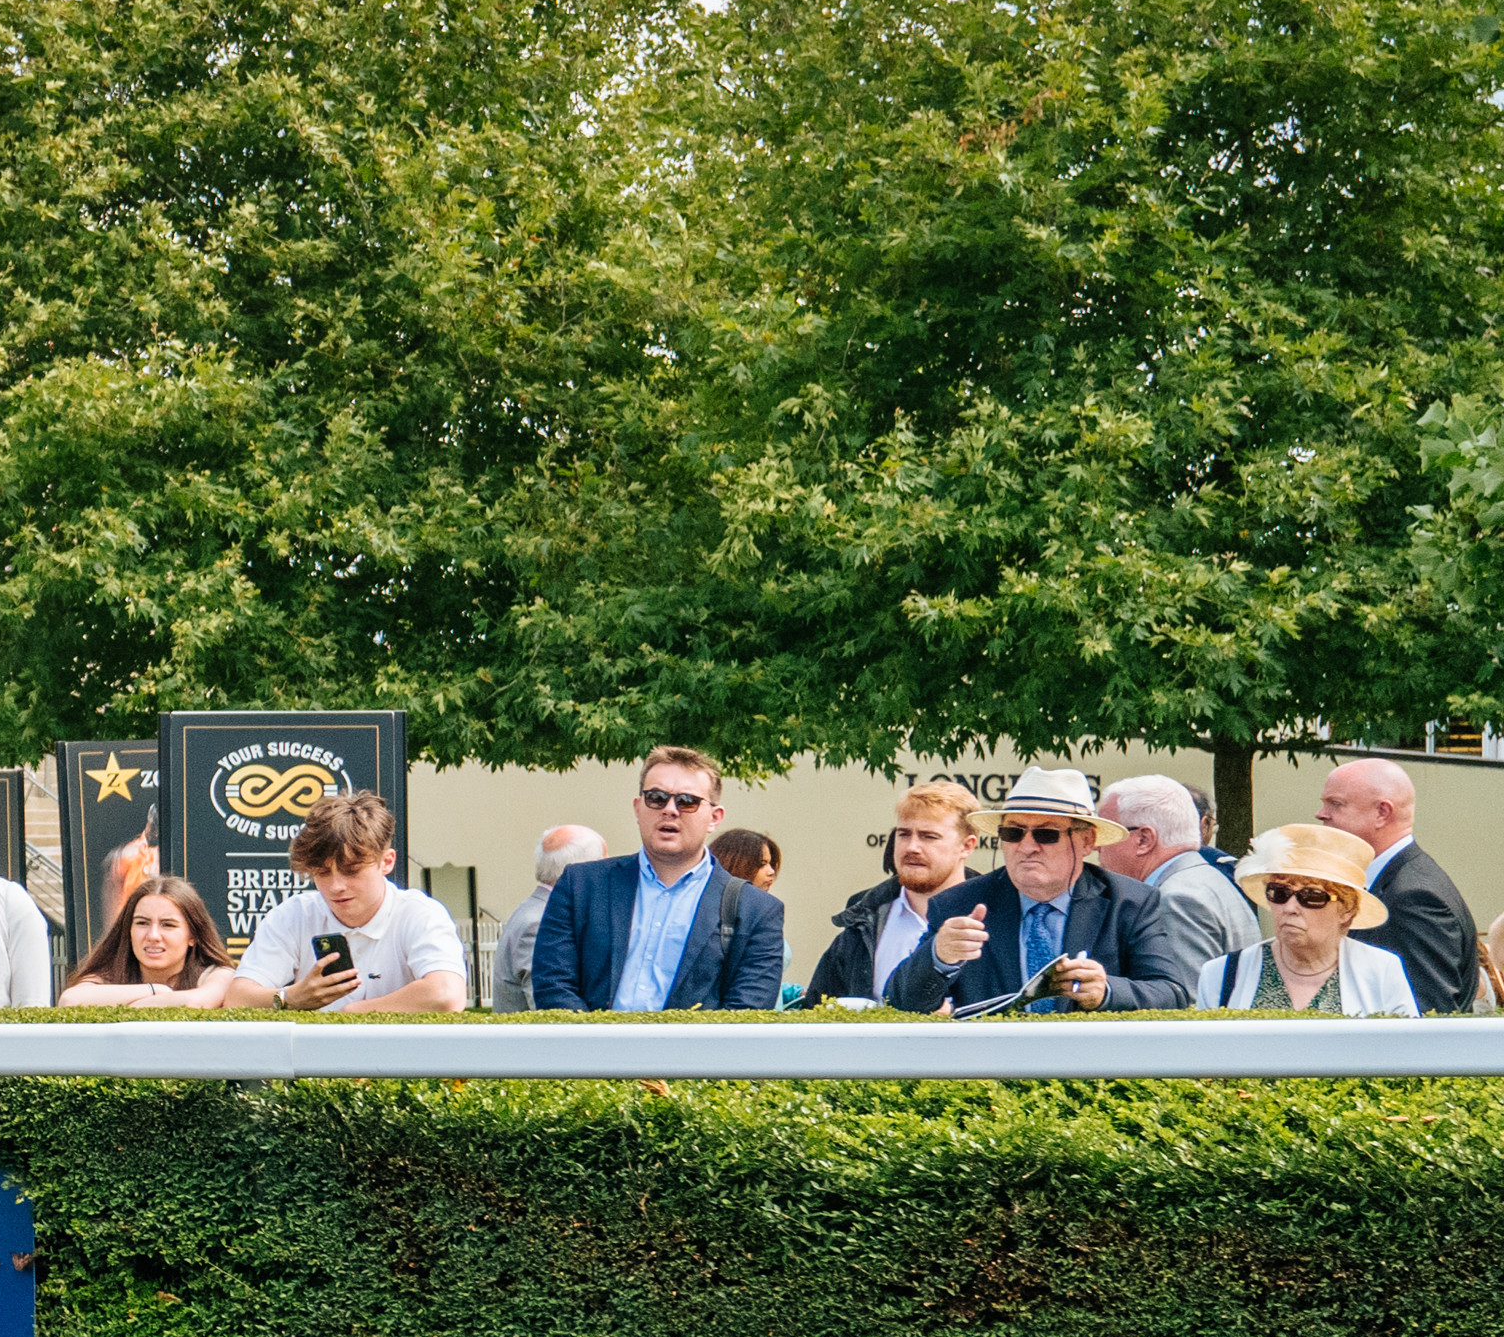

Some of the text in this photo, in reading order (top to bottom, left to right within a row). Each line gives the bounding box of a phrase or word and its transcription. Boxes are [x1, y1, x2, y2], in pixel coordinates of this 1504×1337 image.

[217, 742, 344, 771] YOUR SUCCESS
[106, 772, 121, 788] Z
[225, 813, 262, 838] OUR
